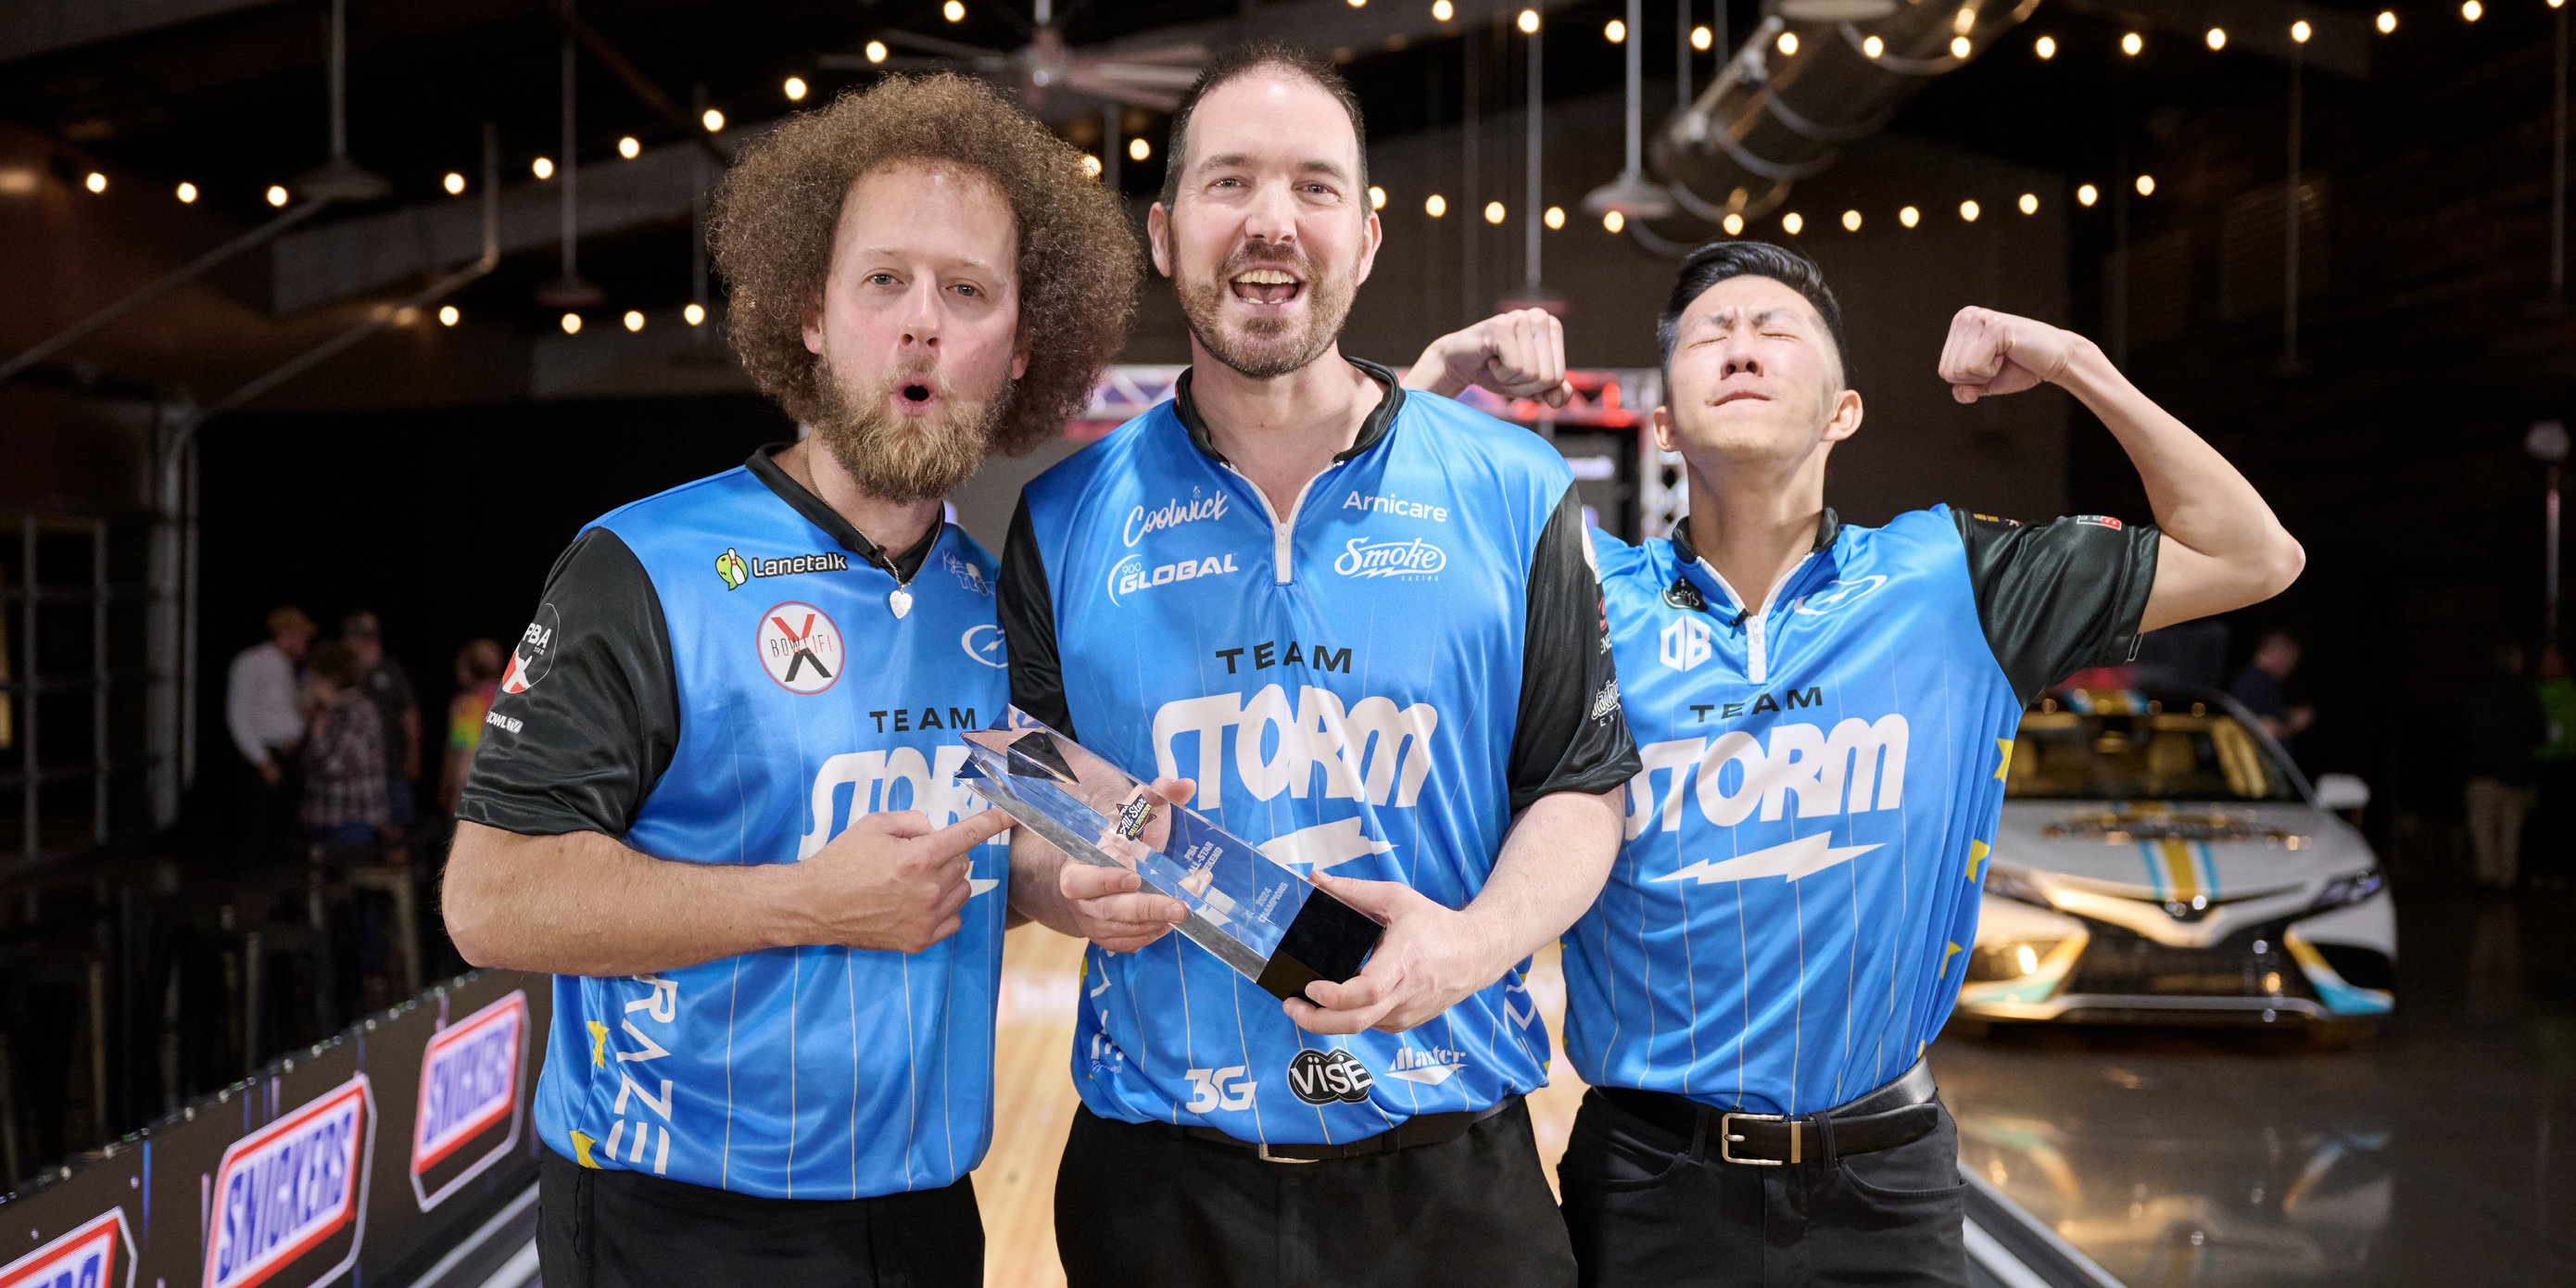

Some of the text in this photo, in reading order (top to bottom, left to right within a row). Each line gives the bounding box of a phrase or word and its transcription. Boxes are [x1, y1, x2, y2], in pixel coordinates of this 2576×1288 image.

[1123, 489, 1229, 548] Coolwick
[1343, 491, 1447, 522] Arnicare
[751, 552, 849, 578] Lanetalk
[1122, 562, 1142, 575] 900
[1334, 536, 1439, 575] Smoke
[1118, 554, 1239, 596] GLOBAL
[523, 623, 551, 650] PBA
[1216, 640, 1352, 675] TEAM
[869, 707, 977, 733] TEAM
[1689, 686, 1823, 723] TEAM
[1152, 683, 1438, 812] STORM
[1624, 713, 1910, 841] STORM
[1183, 844, 1199, 862] PBA
[1389, 1045, 1466, 1071] Master
[1184, 1065, 1258, 1114] 3G
